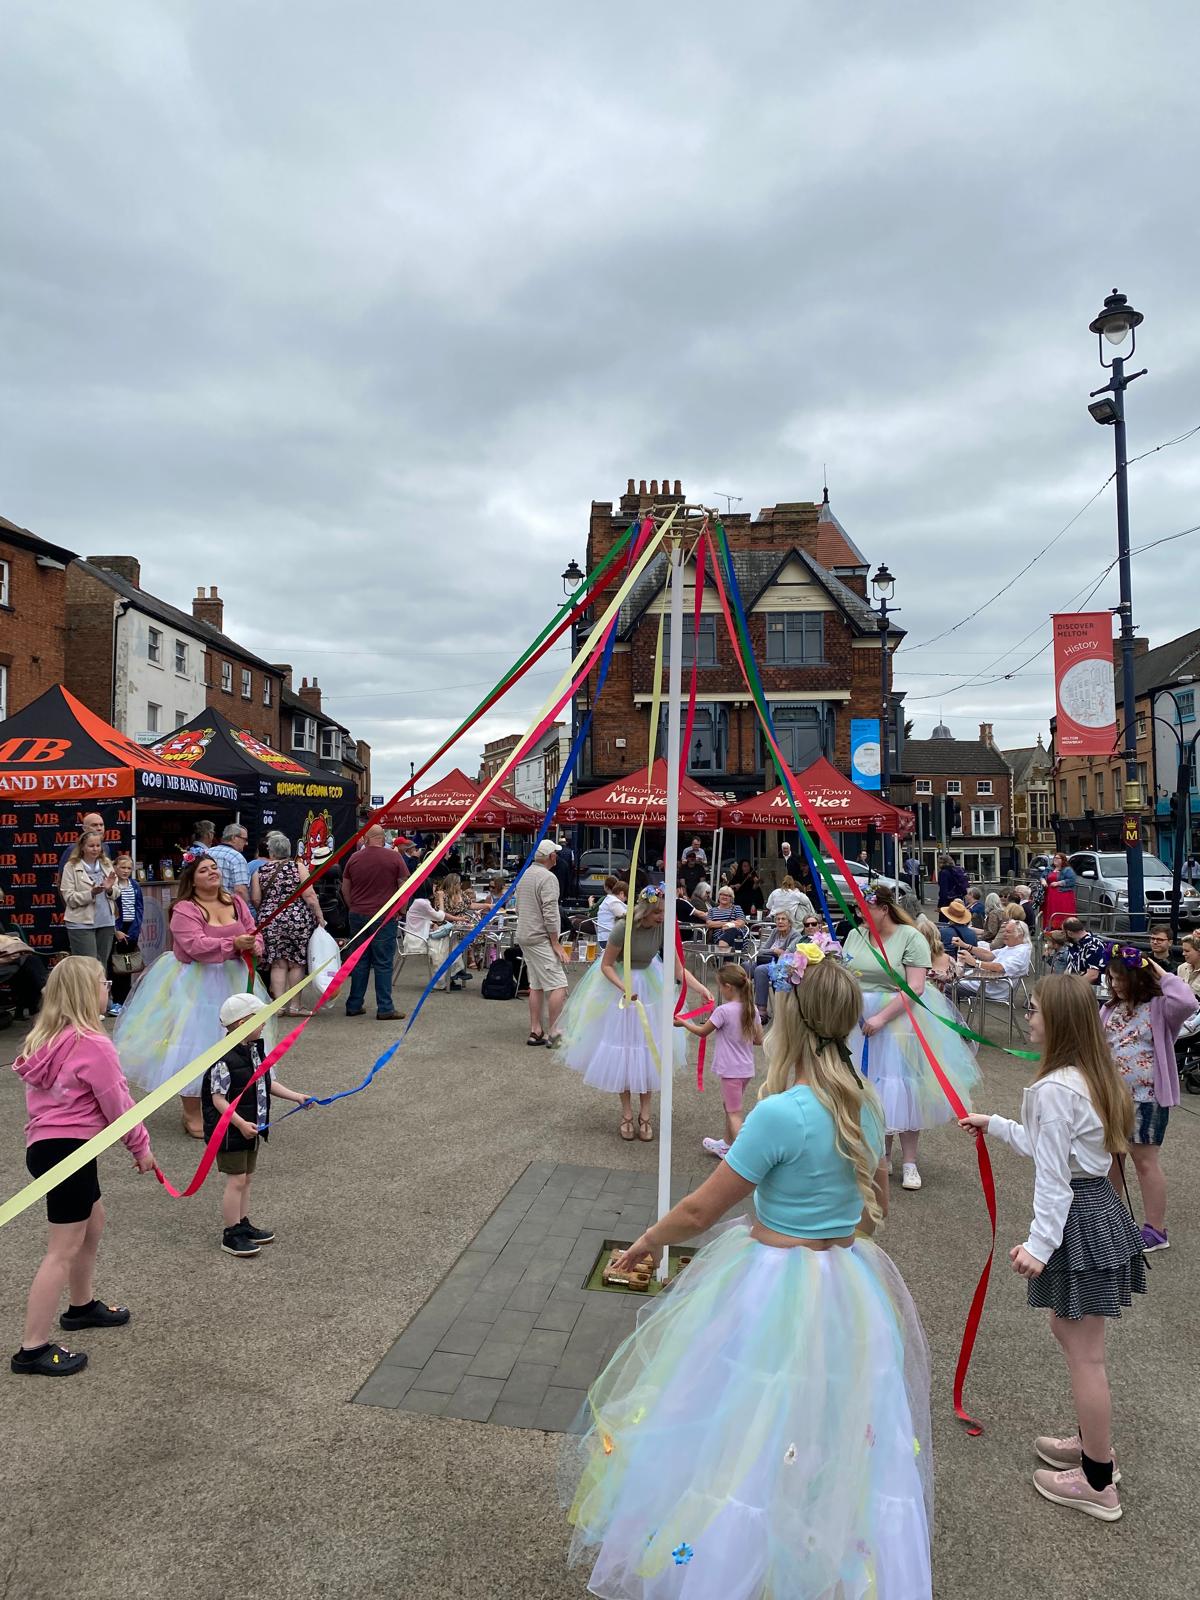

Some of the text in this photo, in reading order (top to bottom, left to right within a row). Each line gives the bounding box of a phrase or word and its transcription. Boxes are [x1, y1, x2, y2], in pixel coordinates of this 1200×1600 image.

[1057, 622, 1094, 630] DISCOVER
[1063, 640, 1099, 656] History
[0, 773, 118, 790] AND EVENTS
[167, 775, 238, 801] MB BARS AND EVENTS
[276, 782, 344, 799] AUTHENTIC GERMAN FOOD
[614, 784, 651, 794] Melton
[820, 788, 852, 796] Town
[410, 797, 473, 807] Market
[605, 791, 669, 806] Marke
[35, 813, 60, 825] MB
[393, 814, 423, 823] Melton
[424, 814, 447, 823] Town
[585, 810, 619, 821] Melton
[620, 811, 648, 821] Town
[751, 812, 789, 825] Melton
[823, 817, 862, 826] Market
[14, 832, 38, 845] MB
[55, 831, 80, 844] MB
[1126, 830, 1138, 841] M
[33, 853, 58, 865] MB
[12, 873, 37, 885] MB
[32, 893, 56, 905] MB
[10, 913, 35, 925] MB
[29, 934, 53, 946] MB
